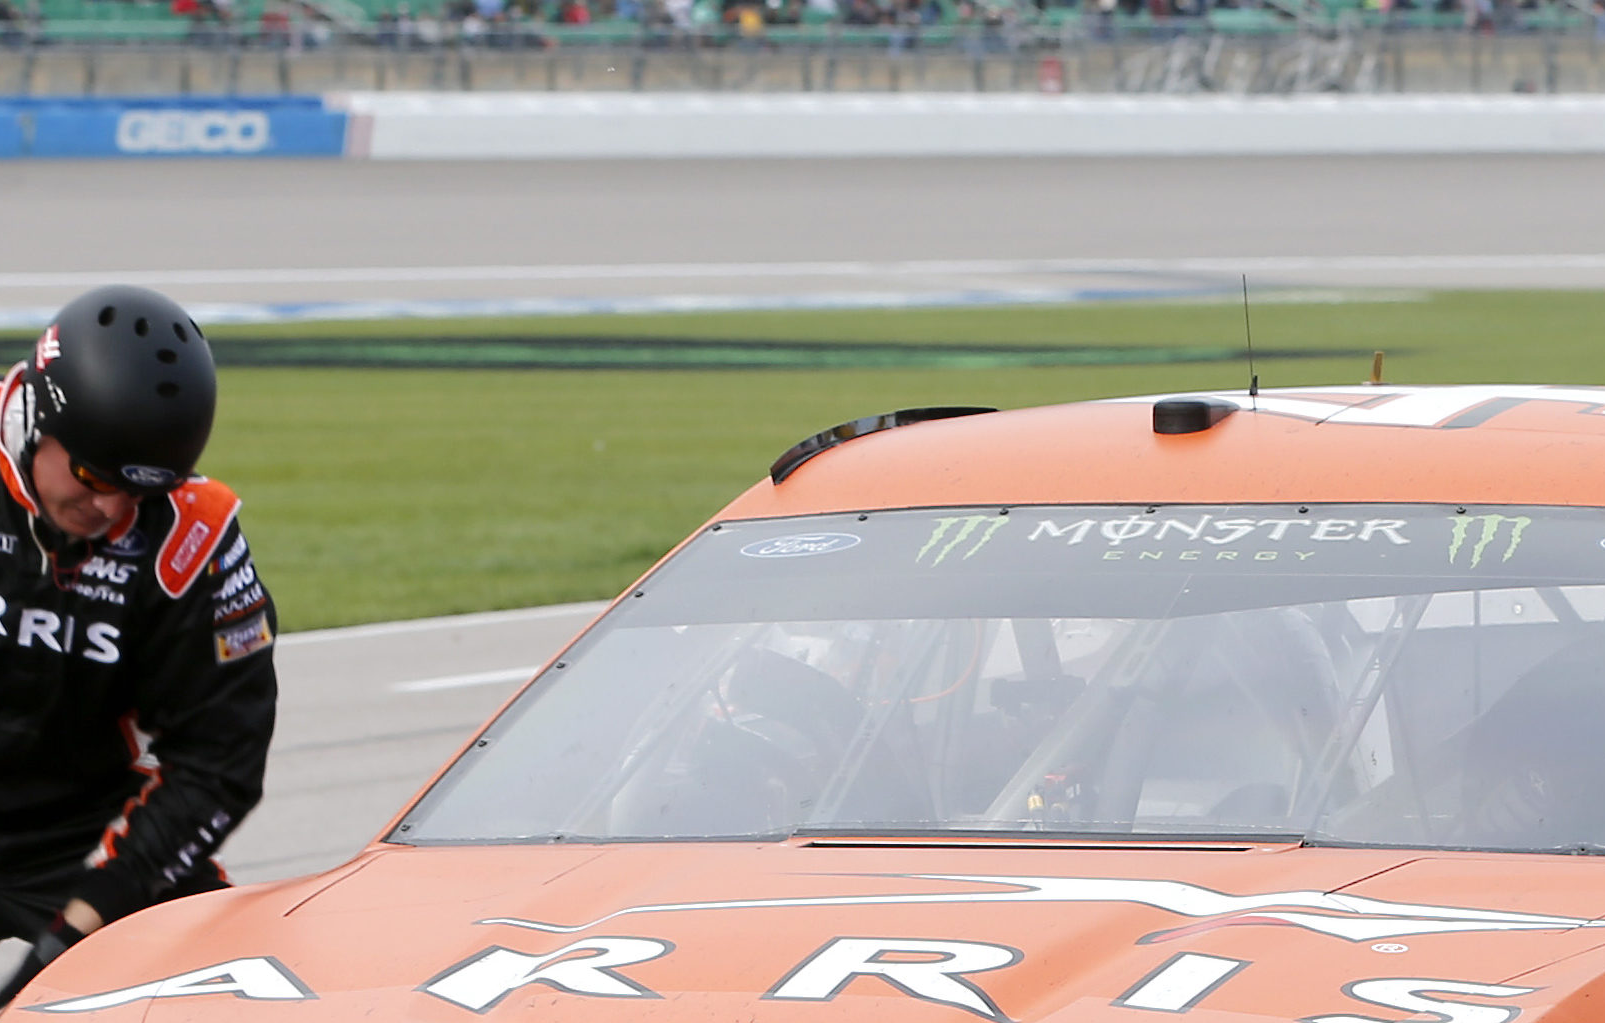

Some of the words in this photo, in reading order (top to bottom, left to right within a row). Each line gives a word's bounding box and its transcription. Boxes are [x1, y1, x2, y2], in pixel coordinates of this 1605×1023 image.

[117, 110, 269, 153] GEICO
[759, 534, 848, 558] Ford
[1103, 549, 1316, 563] ENERGY
